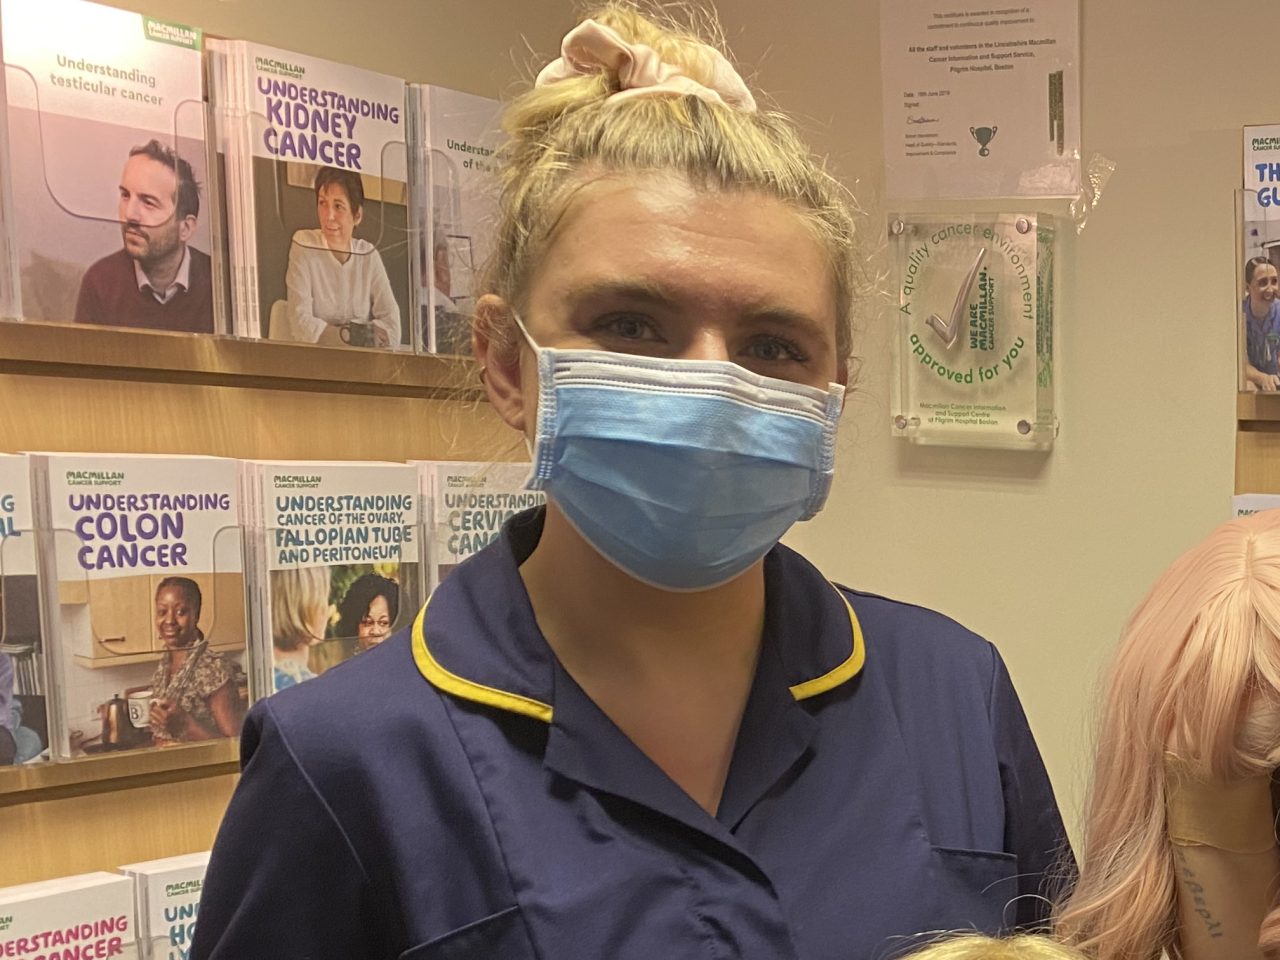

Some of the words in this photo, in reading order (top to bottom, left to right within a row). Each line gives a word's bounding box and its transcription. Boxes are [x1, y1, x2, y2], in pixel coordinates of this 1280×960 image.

[148, 20, 197, 40] MACMILLAN
[56, 54, 157, 88] Understanding
[255, 56, 306, 74] MACMILLAN
[50, 72, 117, 97] testicular
[120, 87, 164, 105] cancer
[257, 76, 400, 124] UNDERSTANDING
[266, 97, 357, 139] KIDNEY
[264, 127, 362, 170] CANCER
[463, 158, 473, 169] of
[931, 223, 978, 245] cancer
[903, 241, 930, 296] quality
[982, 227, 1033, 320] environment
[900, 302, 911, 315] A
[969, 303, 978, 328] ARE
[969, 329, 978, 349] WE
[910, 333, 974, 384] approved
[978, 363, 1000, 382] for
[1002, 336, 1025, 370] you
[66, 471, 125, 480] MACMILLAN
[273, 475, 322, 483] MACMILLAN
[68, 493, 231, 512] UNDERSTANDING
[275, 494, 412, 512] UNDERSTANDING
[75, 511, 184, 542] COLON
[277, 512, 326, 526] CANCER
[328, 512, 343, 525] OF
[344, 512, 366, 525] THE
[367, 511, 405, 525] OVARY,
[275, 526, 369, 548] FALLOPIAN
[371, 524, 413, 543] TUBE
[77, 543, 188, 570] CANCER
[278, 547, 310, 565] AND
[312, 544, 402, 563] PERITONEUM
